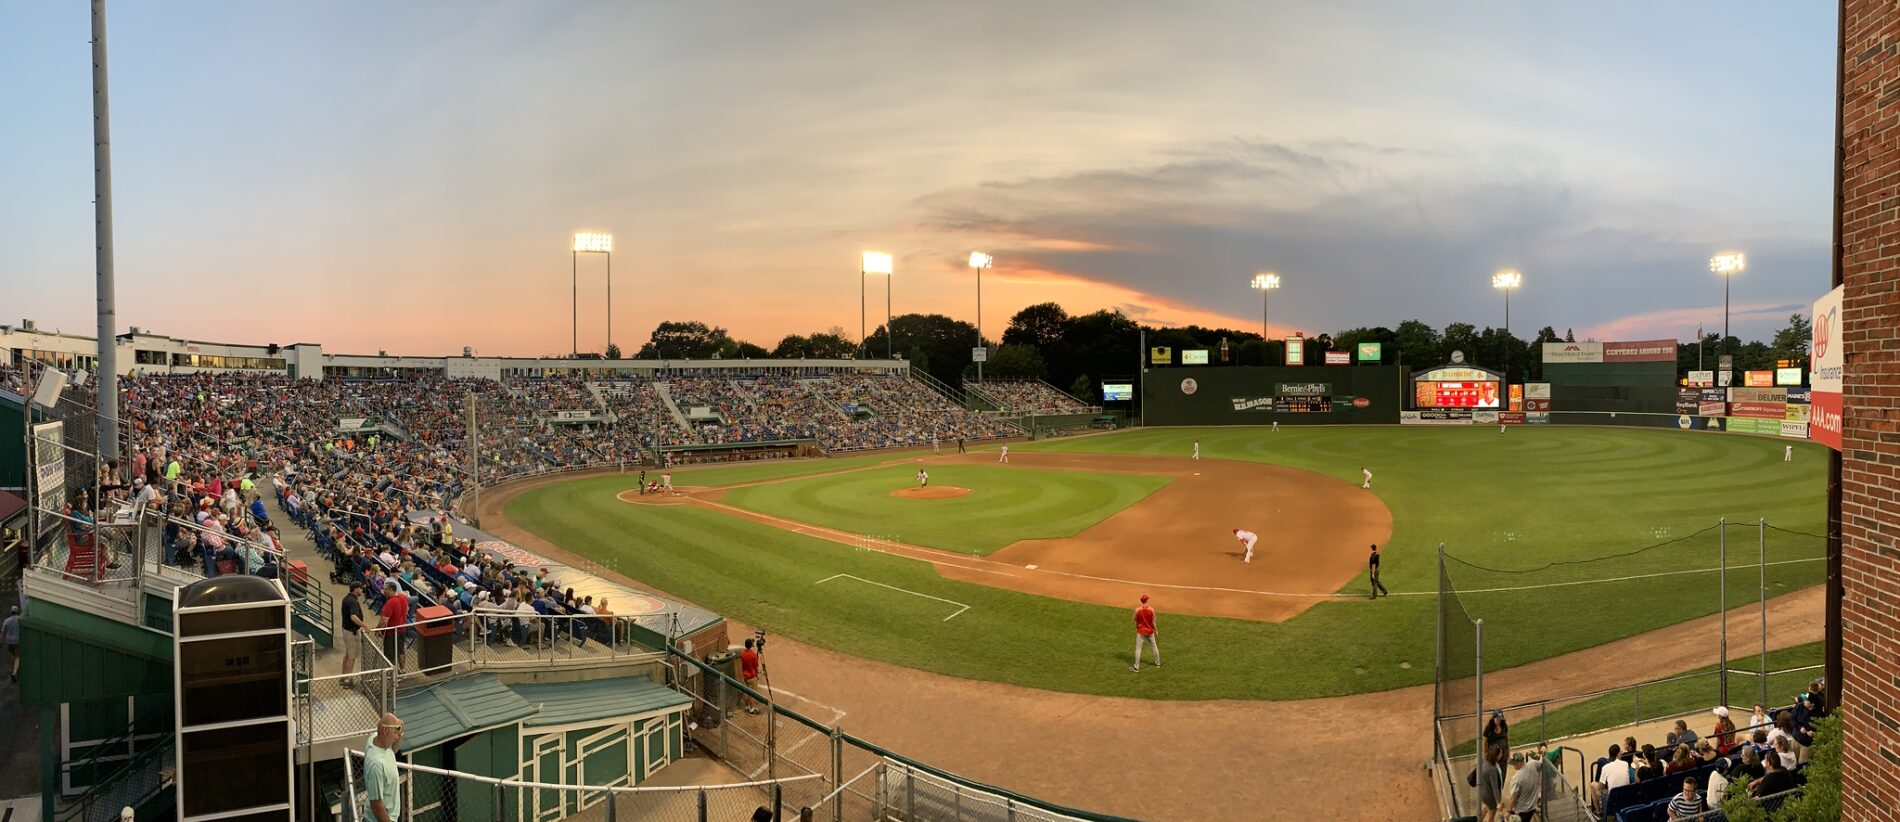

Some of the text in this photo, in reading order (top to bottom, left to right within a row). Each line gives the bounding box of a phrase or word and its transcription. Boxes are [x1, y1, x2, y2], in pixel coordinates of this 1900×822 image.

[1820, 365, 1842, 380] Insurance
[1757, 394, 1787, 402] DELIVER
[1812, 404, 1842, 434] AAA.com
